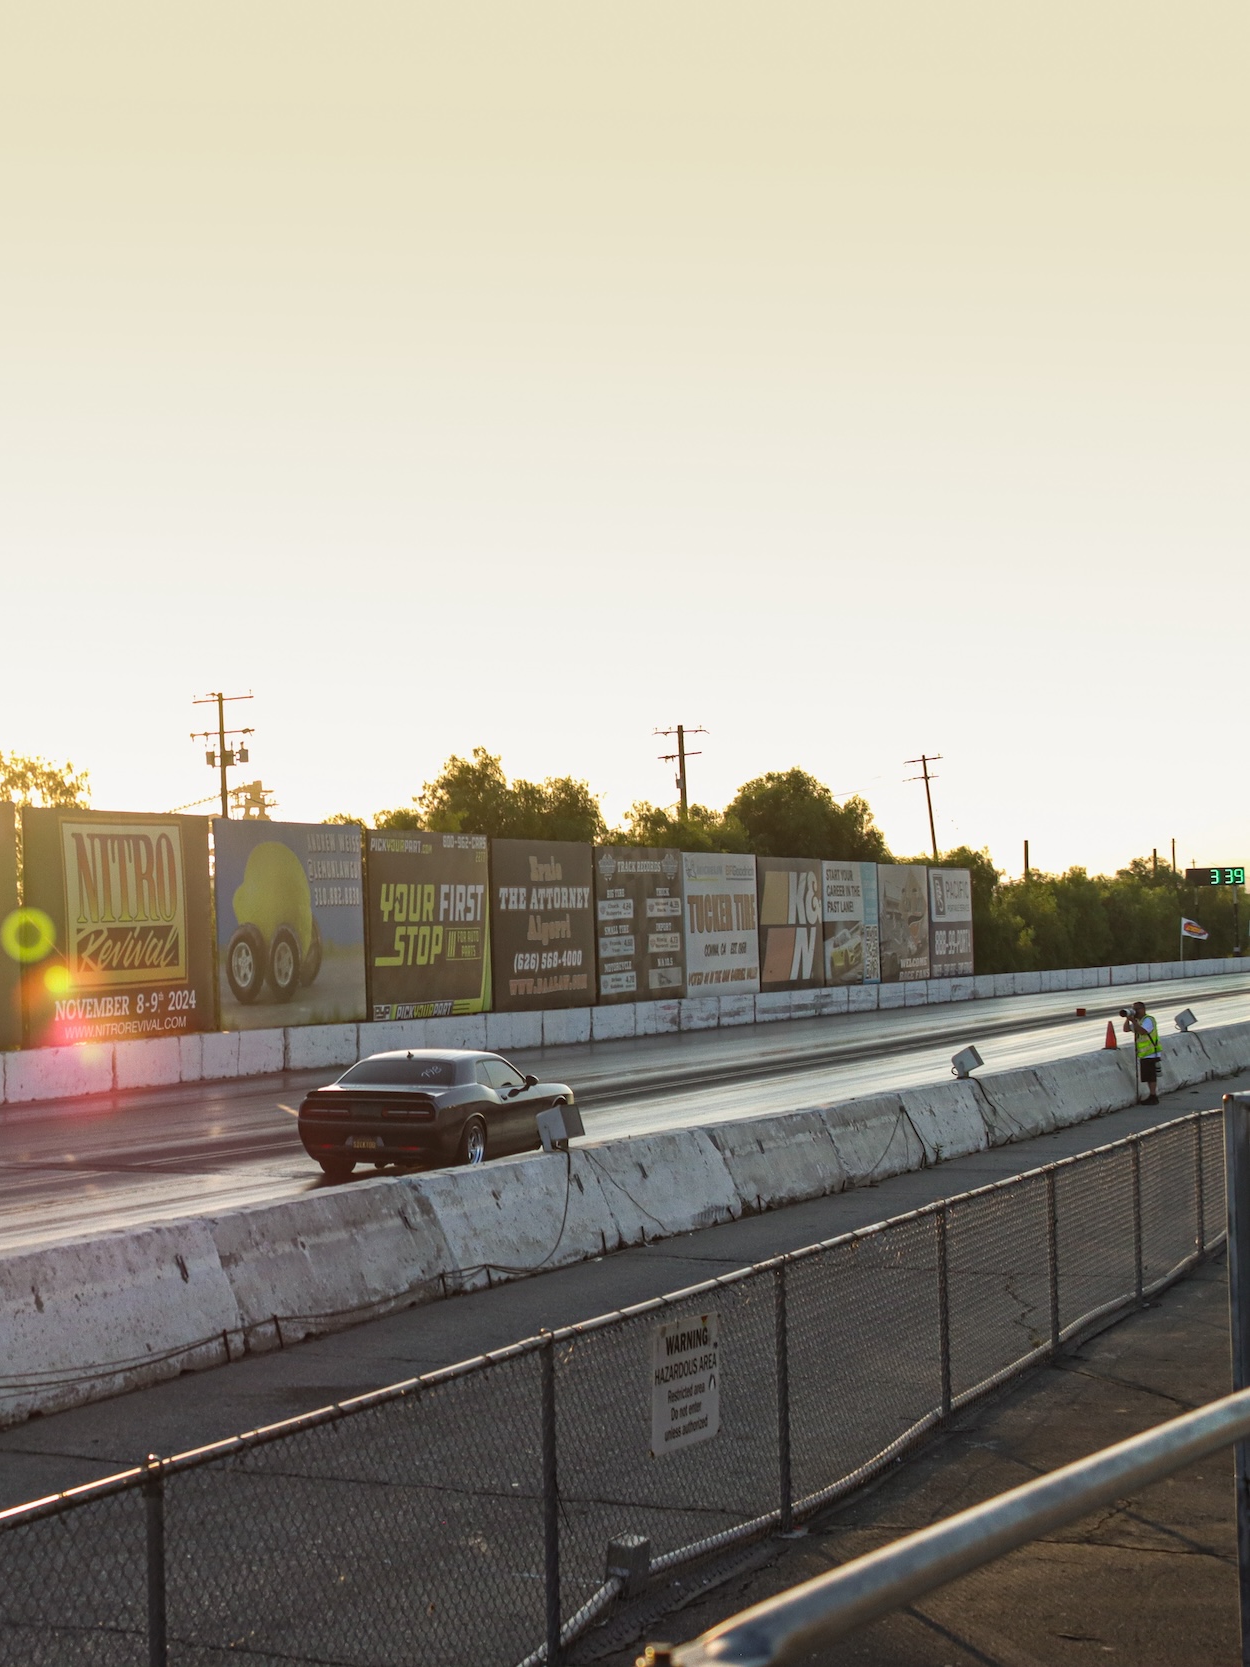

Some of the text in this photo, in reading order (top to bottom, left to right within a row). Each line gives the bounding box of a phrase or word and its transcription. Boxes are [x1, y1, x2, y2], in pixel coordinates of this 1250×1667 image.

[71, 832, 178, 924] NITRO
[617, 861, 637, 873] TRACK
[826, 869, 854, 882] START YOUR
[380, 883, 485, 922] YOUR FIRST
[499, 887, 590, 910] THE ATTORNEY
[787, 871, 822, 925] K&
[827, 885, 861, 897] CAREER IN THE
[687, 893, 756, 934] TUCKER TIRE
[827, 901, 840, 913] FAST
[76, 925, 179, 973] Revival
[375, 925, 443, 967] STOP
[789, 927, 817, 981] N
[513, 949, 582, 973] (626) 568-4000
[900, 957, 928, 968] WELCOME
[915, 968, 930, 979] FANS
[55, 995, 130, 1022] NOVEMBER
[168, 989, 197, 1011] 2024
[64, 1016, 187, 1040] WWW.NITROREVIVAL.COM
[665, 1327, 708, 1356] WARNING
[654, 1352, 717, 1386] HAZARDOUS AREA
[667, 1382, 706, 1404] Restricted area
[670, 1401, 702, 1421] Do not enter
[664, 1416, 708, 1442] unless authorized
